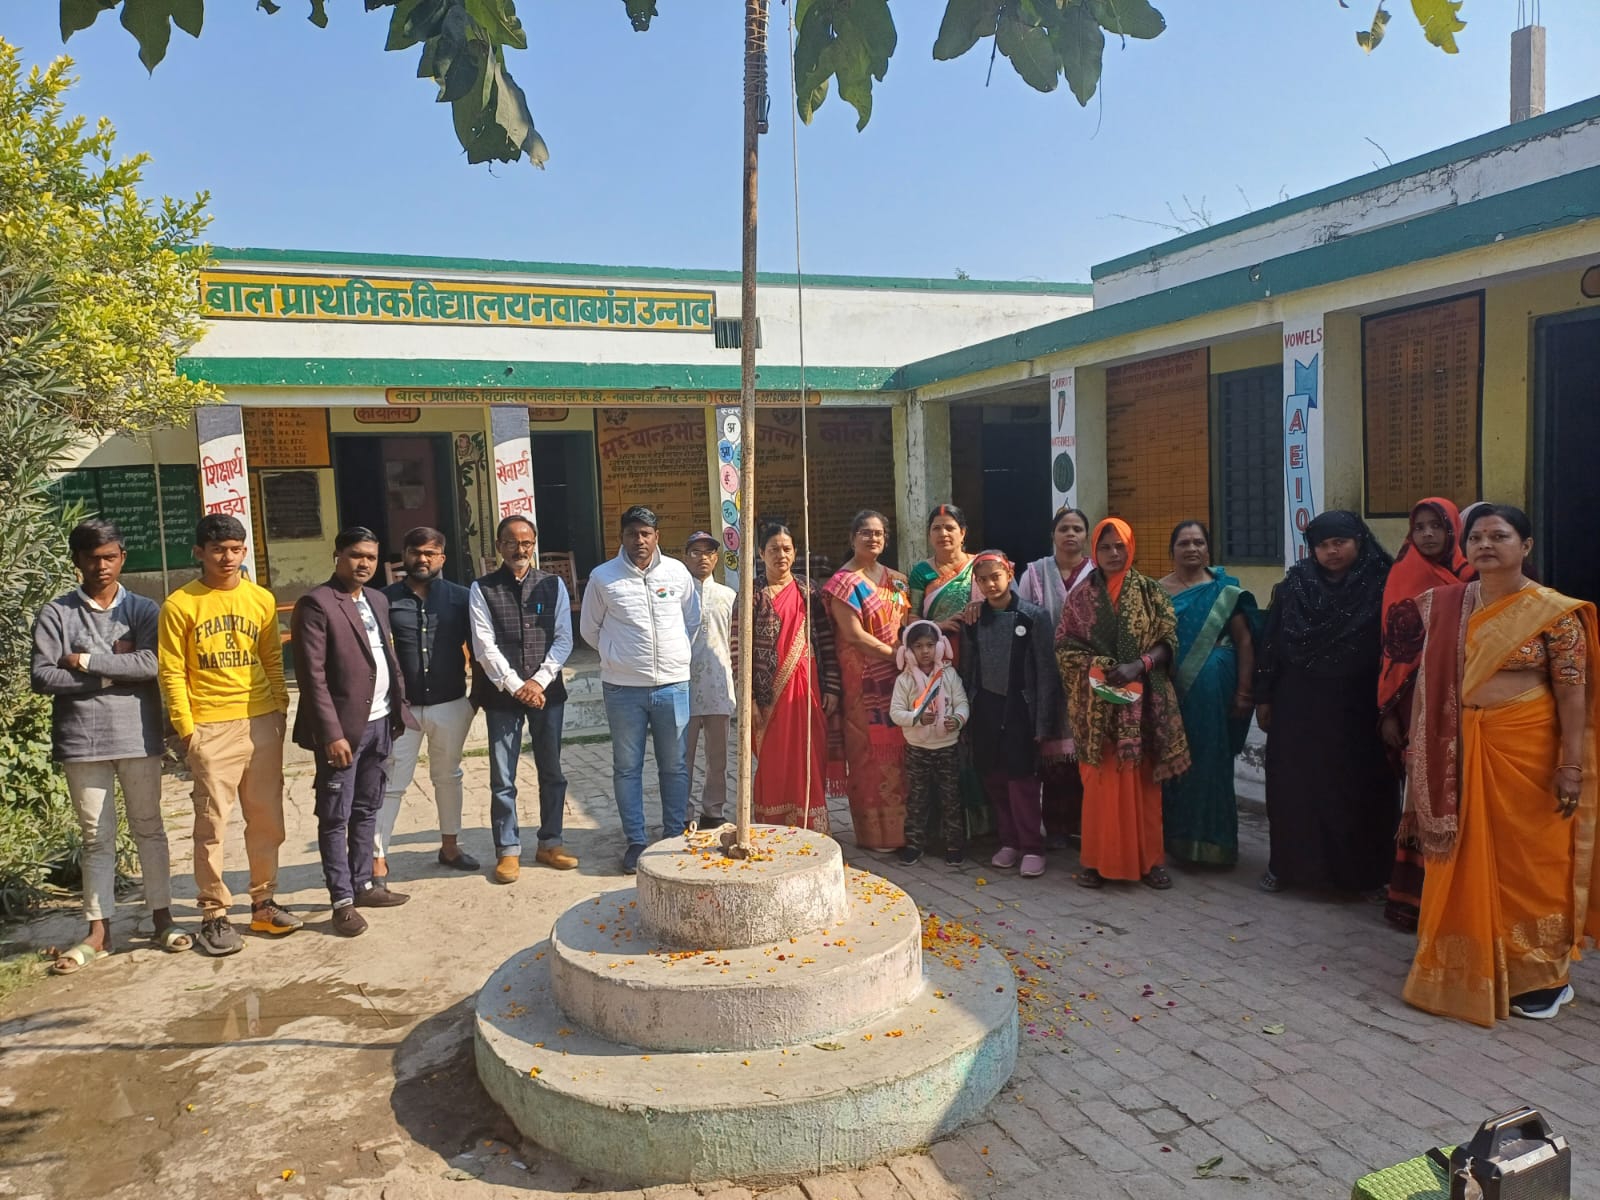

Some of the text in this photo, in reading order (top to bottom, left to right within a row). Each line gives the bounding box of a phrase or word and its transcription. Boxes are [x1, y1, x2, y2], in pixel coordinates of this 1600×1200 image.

[204, 277, 711, 327] बाल प्राथमिक विद्यालय नवाबगंज उन्नाव
[1284, 328, 1322, 349] VOWELS
[195, 615, 259, 644] FRANKLIN
[225, 633, 235, 650] &
[197, 650, 259, 670] MARSHAL
